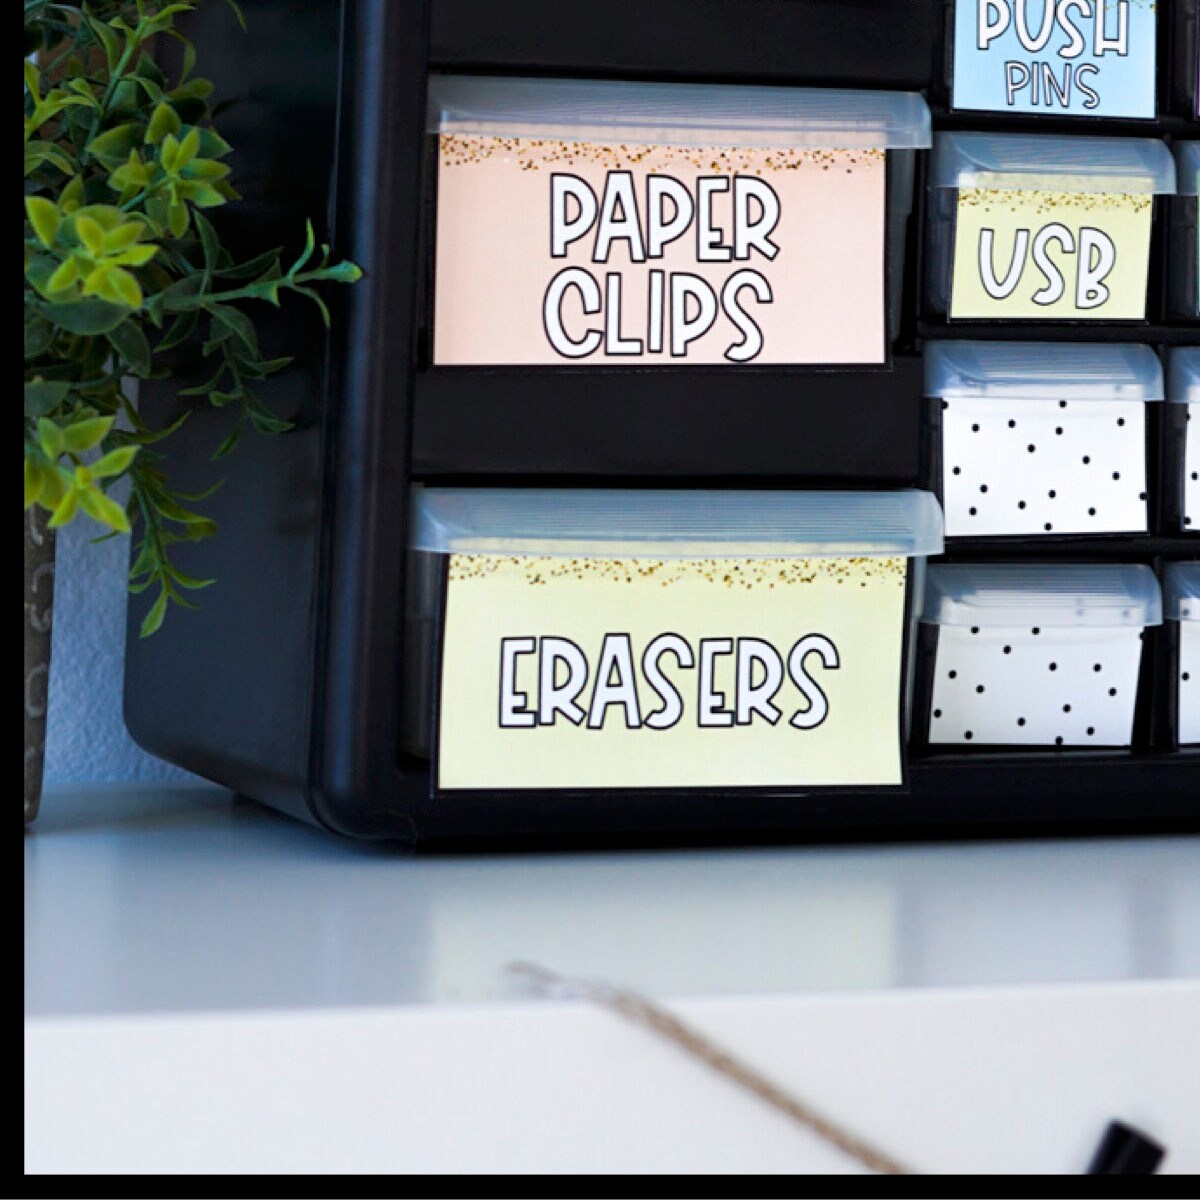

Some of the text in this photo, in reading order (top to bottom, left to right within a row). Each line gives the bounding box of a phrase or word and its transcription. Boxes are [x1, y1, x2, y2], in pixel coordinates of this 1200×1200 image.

[1004, 61, 1100, 109] PINS
[550, 170, 782, 265] PAPER
[978, 222, 1116, 309] USB
[543, 266, 773, 362] CLIPS
[499, 633, 840, 730] ERASERS
